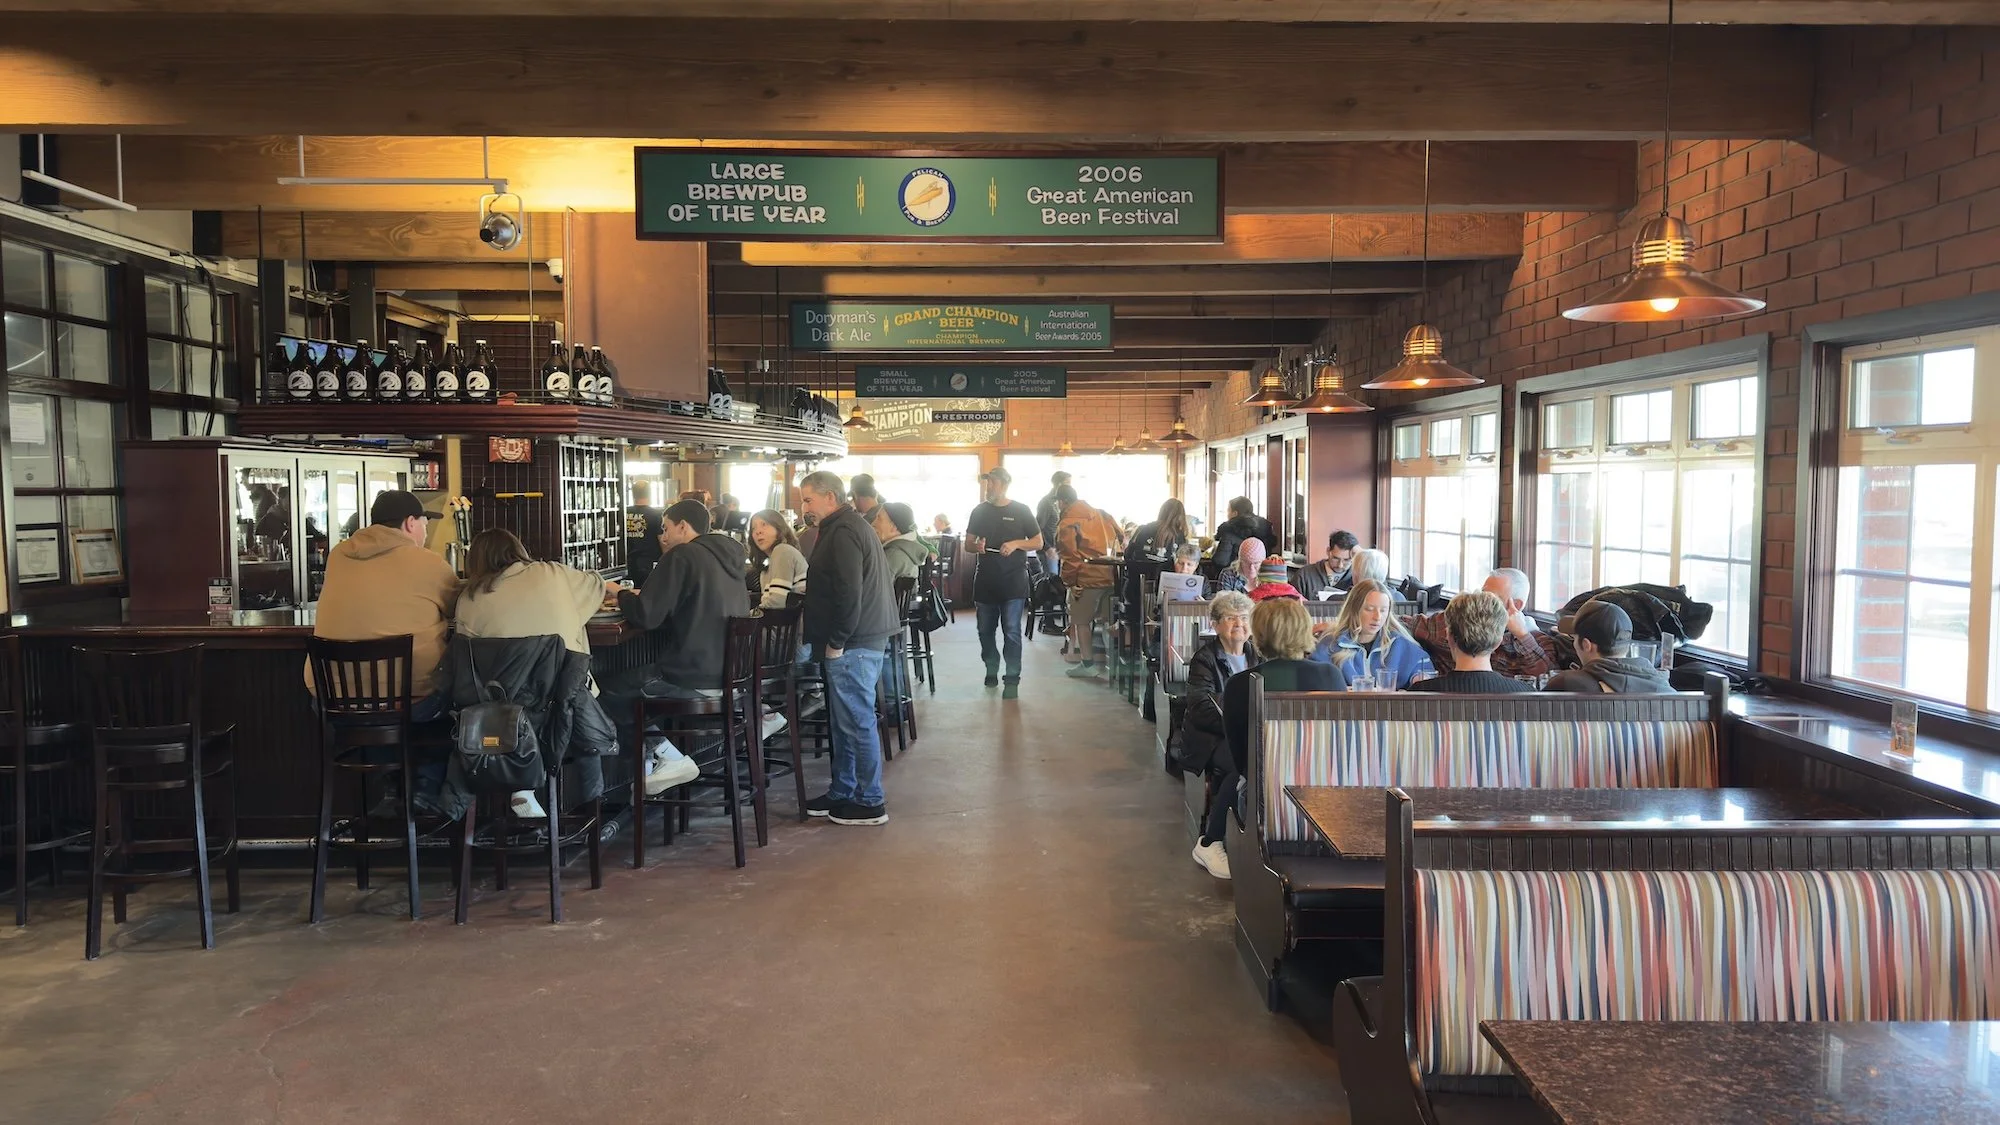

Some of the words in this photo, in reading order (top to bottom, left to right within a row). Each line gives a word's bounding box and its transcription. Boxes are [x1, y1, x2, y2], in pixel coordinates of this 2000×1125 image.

[710, 162, 785, 180] LARGE
[911, 169, 944, 178] PELICAN
[1078, 165, 1143, 183] 2006
[687, 183, 808, 202] BREWPUB
[1026, 186, 1087, 204] Great
[1093, 187, 1194, 204] American
[667, 204, 700, 222] OF
[707, 204, 755, 222] THE
[762, 205, 827, 224] YEAR
[1041, 208, 1091, 225] Beer
[1098, 208, 1179, 225] Festival
[805, 310, 877, 327] Doryman's
[894, 307, 941, 326] GRAND
[945, 306, 1019, 326] CHAMPION
[1048, 309, 1089, 318] Australian
[939, 317, 974, 328] BEER
[1040, 320, 1097, 329] International
[811, 328, 845, 342] Dark
[849, 328, 872, 341] Ale
[1035, 332, 1051, 340] Beer
[1052, 332, 1080, 340] Awards
[1080, 332, 1102, 340] 2005
[1000, 385, 1019, 393] Beer
[1020, 385, 1051, 393] Festival
